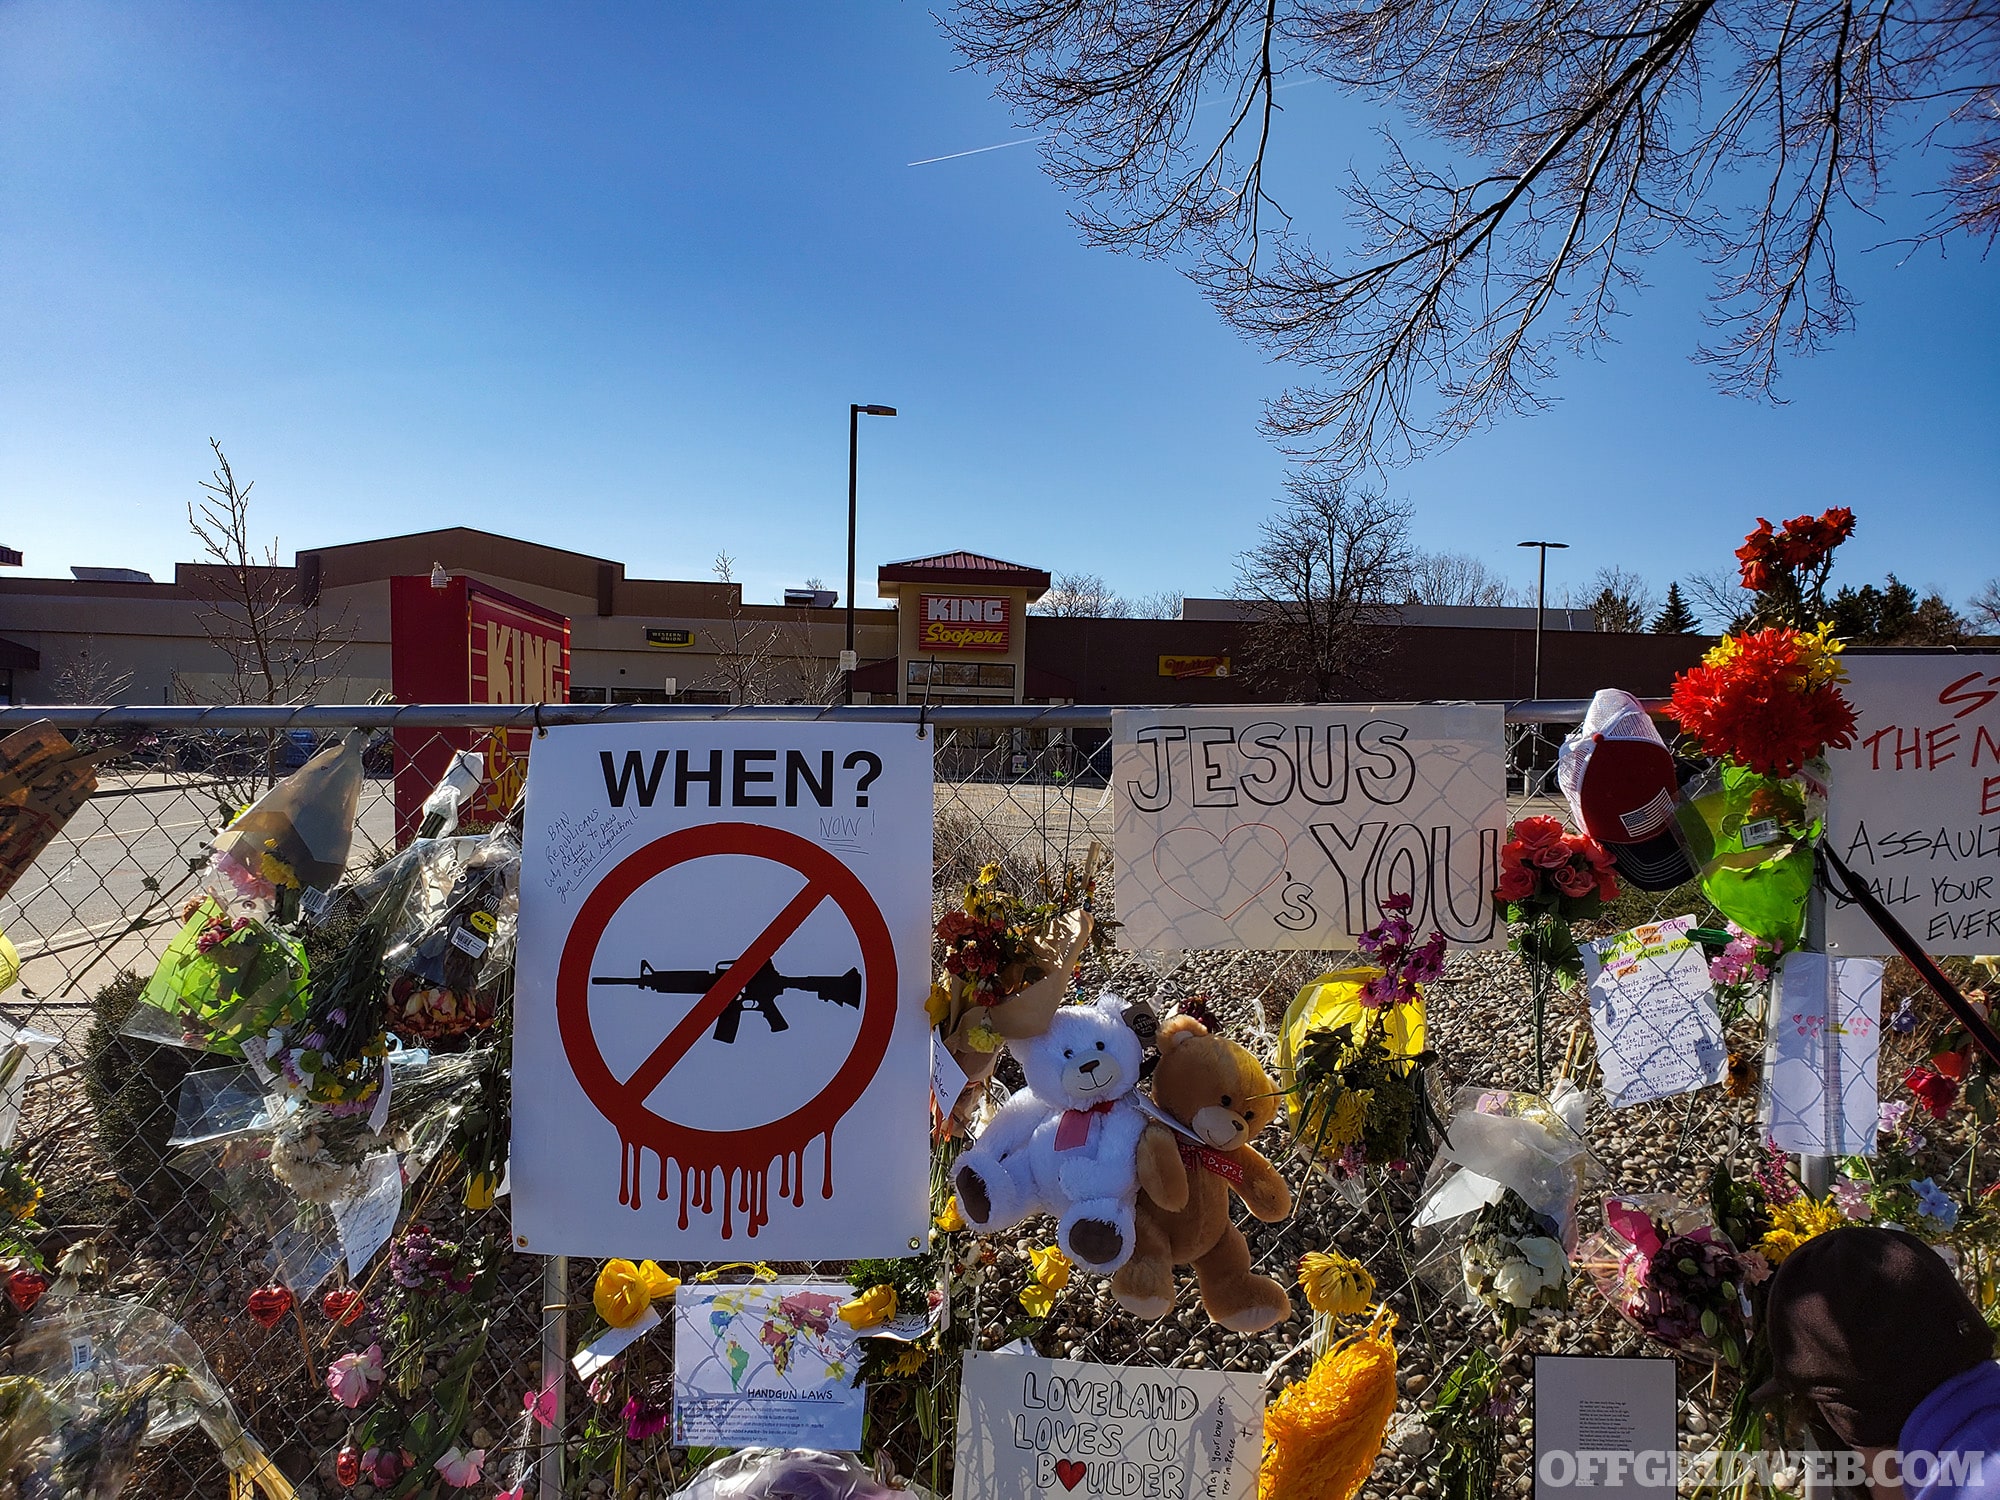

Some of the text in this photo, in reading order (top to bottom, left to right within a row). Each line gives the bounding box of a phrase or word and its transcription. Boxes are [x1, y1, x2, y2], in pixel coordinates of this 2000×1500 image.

[928, 597, 1004, 622] KING
[925, 622, 1004, 648] Soopers
[487, 620, 562, 704] KING
[1862, 722, 1960, 772] THE
[599, 750, 883, 808] WHEN?
[1127, 719, 1416, 813] JESUS
[547, 810, 570, 841] BAN
[587, 827, 598, 841] to
[556, 880, 572, 904] gun
[1309, 821, 1498, 943] YOU
[1931, 876, 1994, 907] YOUR
[747, 1388, 834, 1401] HANDGUN LAWS
[1023, 1371, 1200, 1422] LOVELAND
[1217, 1395, 1226, 1416] ones
[1014, 1413, 1177, 1462] LOVES U
[1211, 1439, 1222, 1463] your
[1206, 1468, 1221, 1499] May
[1223, 1466, 1232, 1476] in
